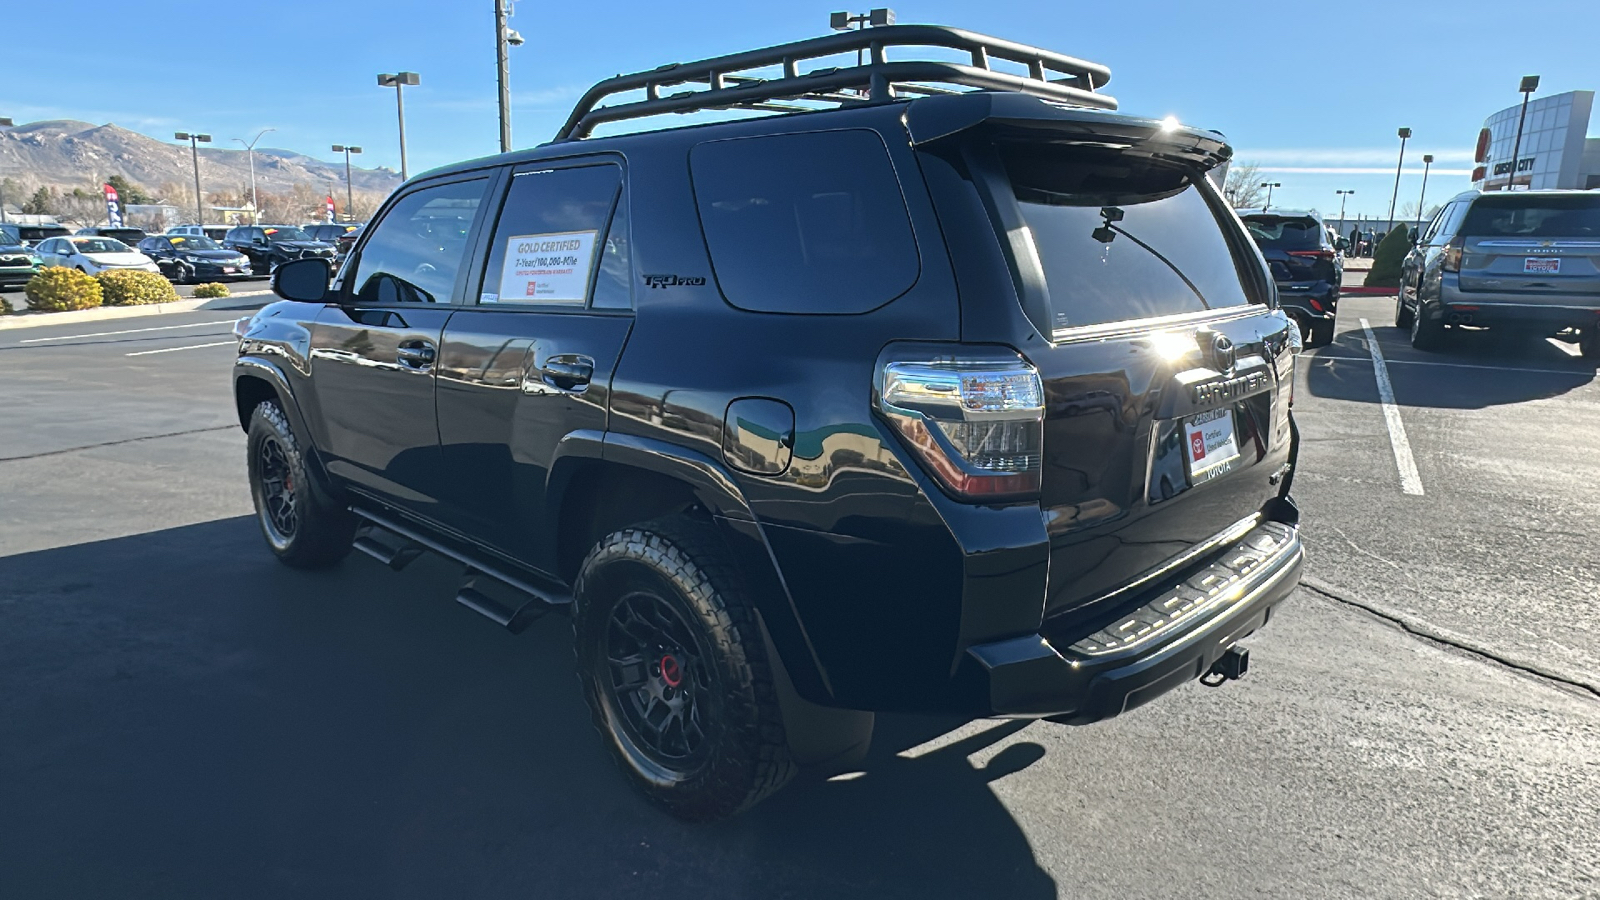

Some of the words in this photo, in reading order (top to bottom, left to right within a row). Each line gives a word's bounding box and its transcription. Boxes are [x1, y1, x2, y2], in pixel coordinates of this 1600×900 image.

[518, 242, 540, 254] GOLD
[540, 240, 580, 252] CERTIFIED
[515, 255, 578, 268] 7-Year/100,000-Mile
[642, 274, 678, 289] TRD
[678, 276, 707, 286] PRO
[1194, 409, 1214, 426] CARSON
[1205, 429, 1222, 441] Certified
[1207, 461, 1232, 480] TOYOTA
